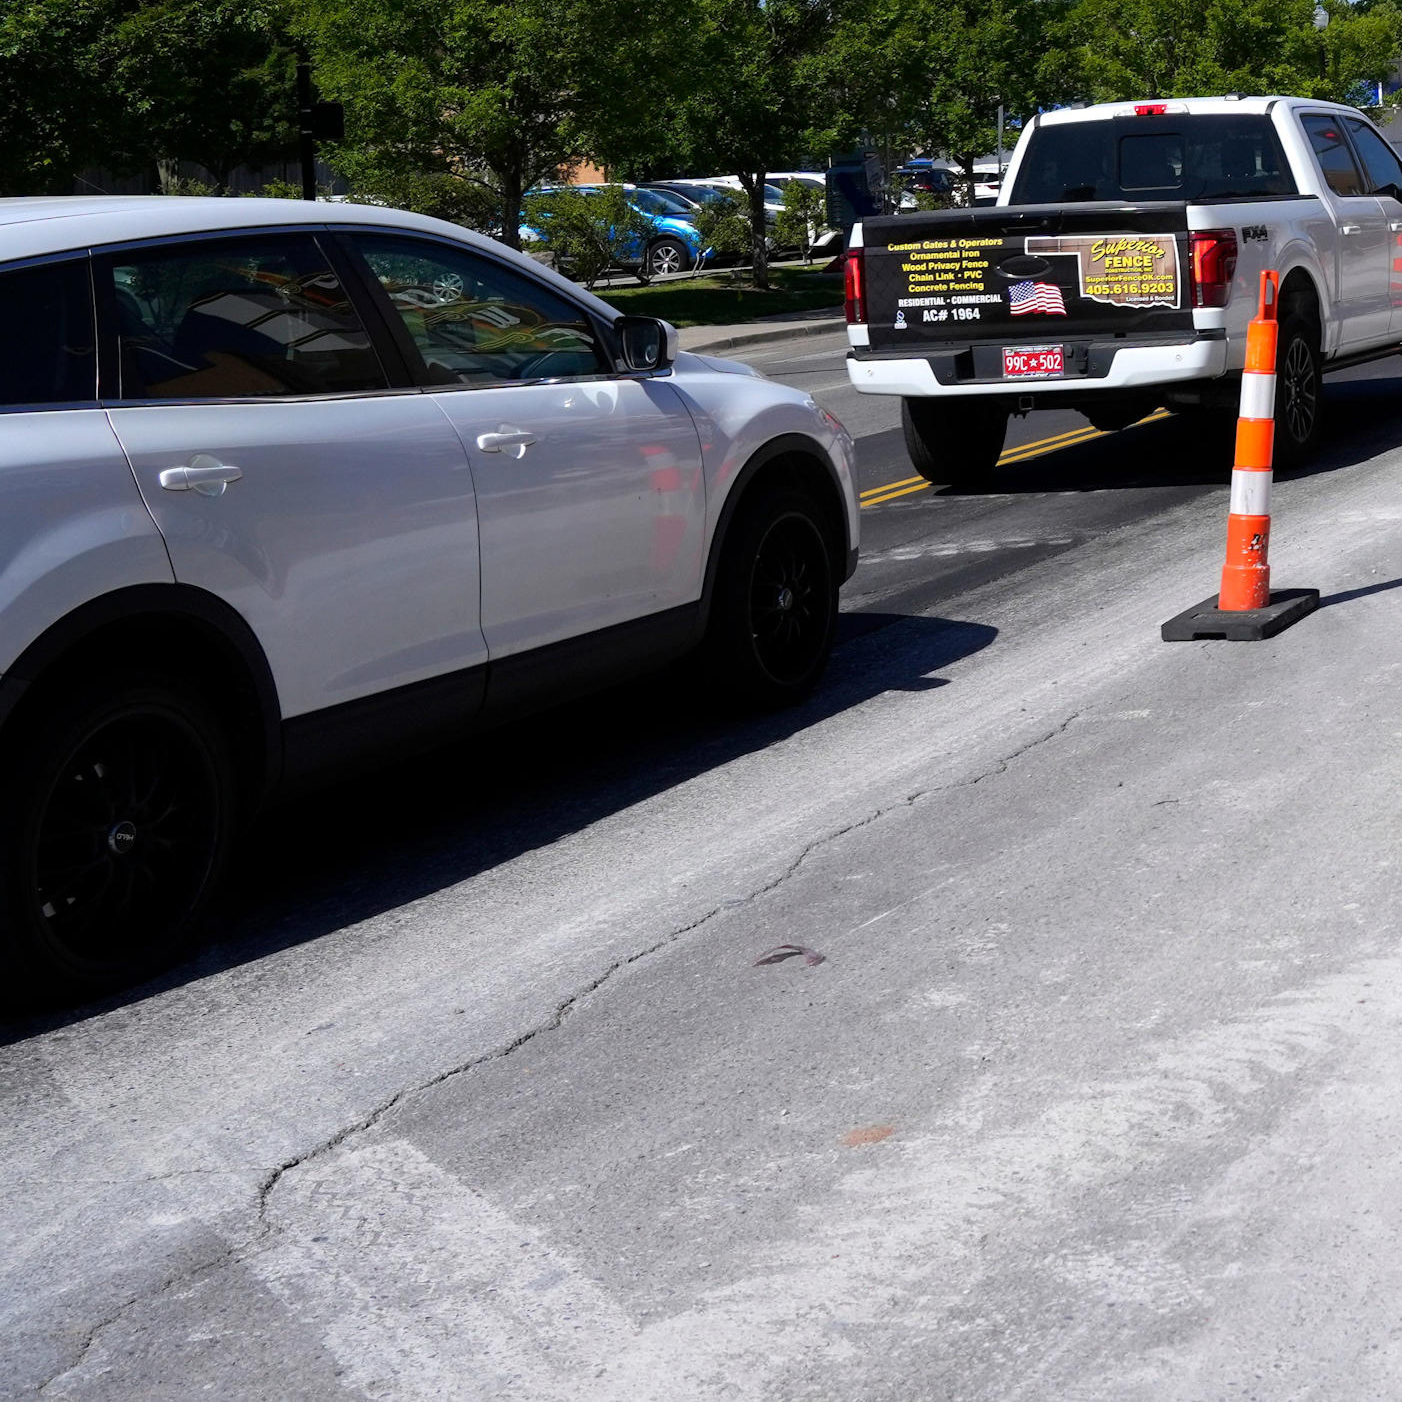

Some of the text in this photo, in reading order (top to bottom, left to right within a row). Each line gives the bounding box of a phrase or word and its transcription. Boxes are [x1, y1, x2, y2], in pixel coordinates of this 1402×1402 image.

[887, 238, 1003, 251] Custom Gates & Operators
[1091, 238, 1166, 262] Superior
[910, 250, 980, 261] Ornamental Iron
[902, 260, 989, 272] Wood Privacy Fence
[1105, 256, 1153, 268] FENCE
[909, 270, 983, 282] Chain Link PVC
[1085, 274, 1174, 284] SuperiorFenceOK.com
[908, 282, 985, 293] Concrete Fencing
[1086, 283, 1174, 295] 405.616.9203
[898, 294, 1003, 307] RESIDENTIAL COMMERCIAL
[922, 308, 981, 322] AC# 1964
[1006, 354, 1062, 371] 99C 502
